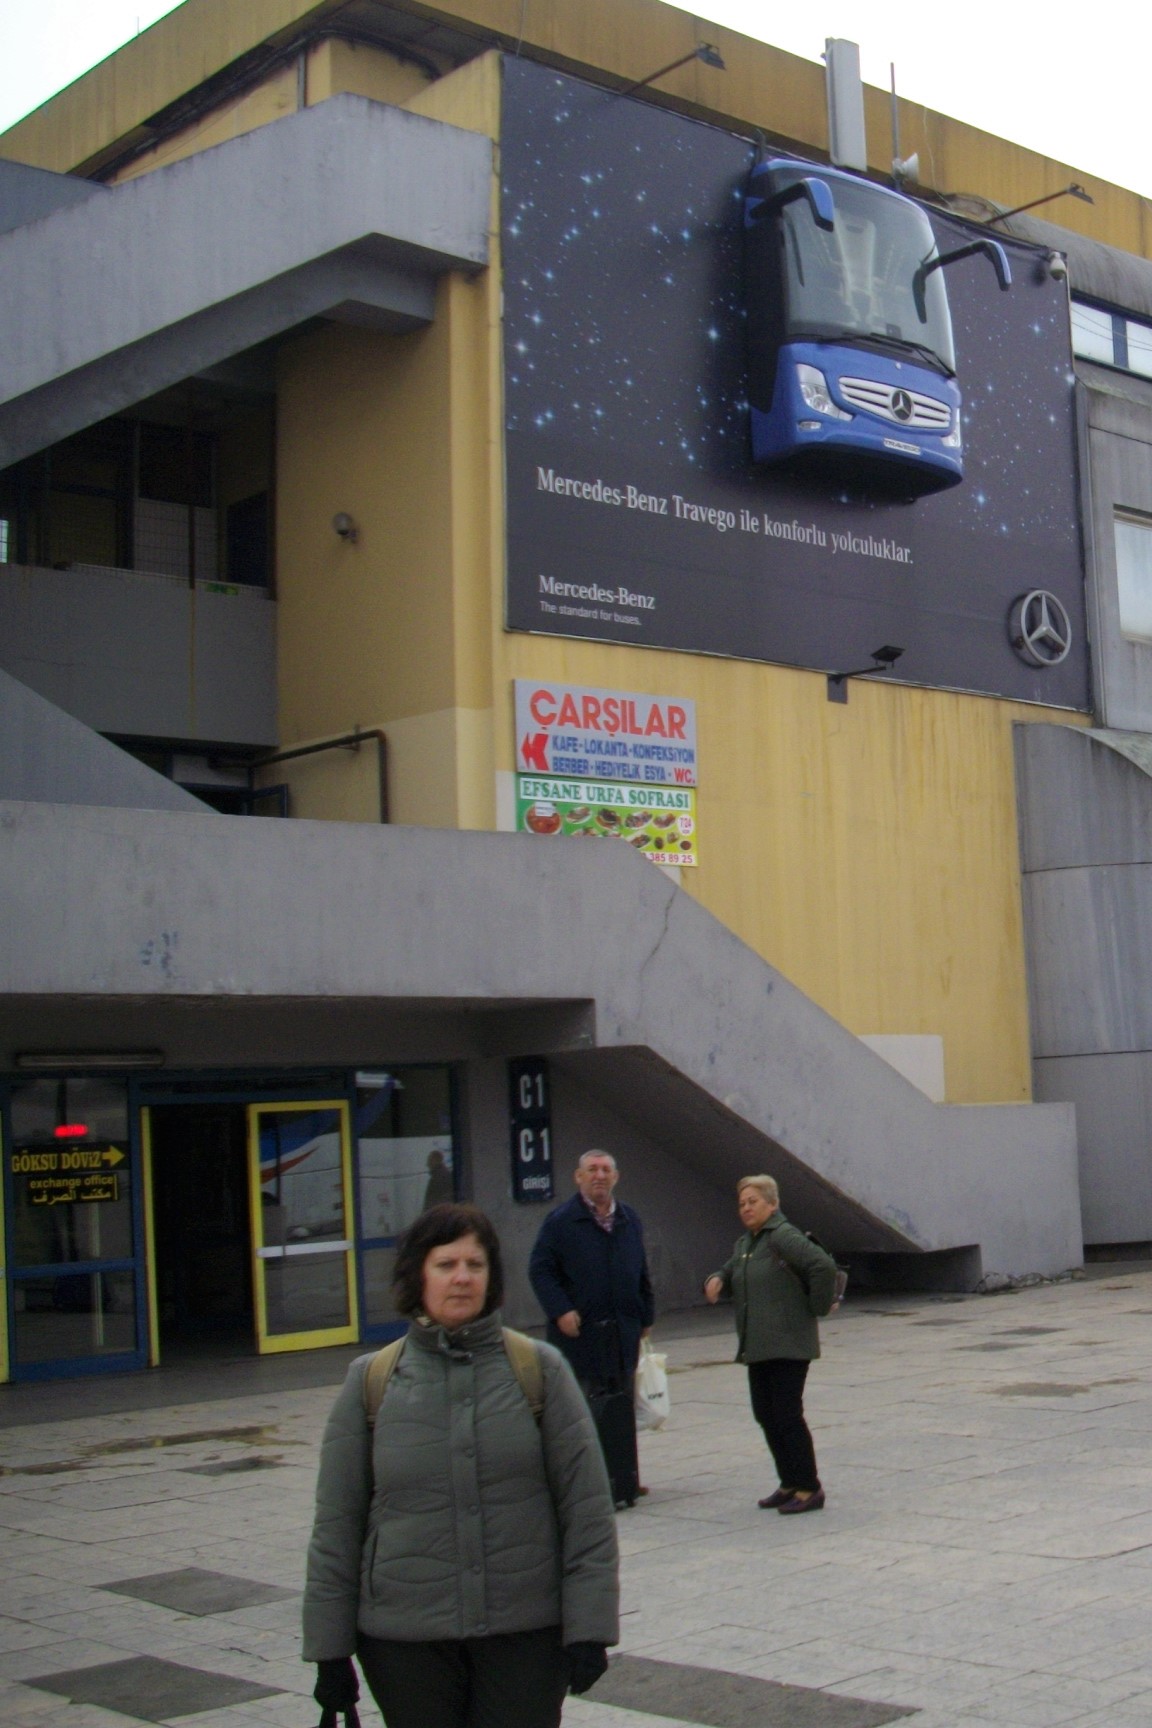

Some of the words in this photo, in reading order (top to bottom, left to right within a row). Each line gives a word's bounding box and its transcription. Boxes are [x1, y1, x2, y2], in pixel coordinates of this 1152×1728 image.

[537, 467, 667, 515] Mercedes-Benz
[673, 495, 735, 532] Travego
[740, 509, 759, 533] ile
[764, 514, 827, 546] konforlu
[832, 531, 914, 564] yolculuklar.
[540, 575, 655, 609] Mercedes-Benz
[540, 601, 557, 613] The
[559, 605, 597, 619] standard
[600, 609, 613, 620] for
[614, 612, 642, 625] buses.
[530, 689, 686, 740] ÇARŞILAR
[523, 781, 582, 800] EFSANE
[586, 786, 624, 804] URFA
[629, 790, 688, 809] SOFRASI
[11, 1150, 58, 1173] GÖKSU
[30, 1177, 81, 1189] exchange
[84, 1174, 114, 1185] office
